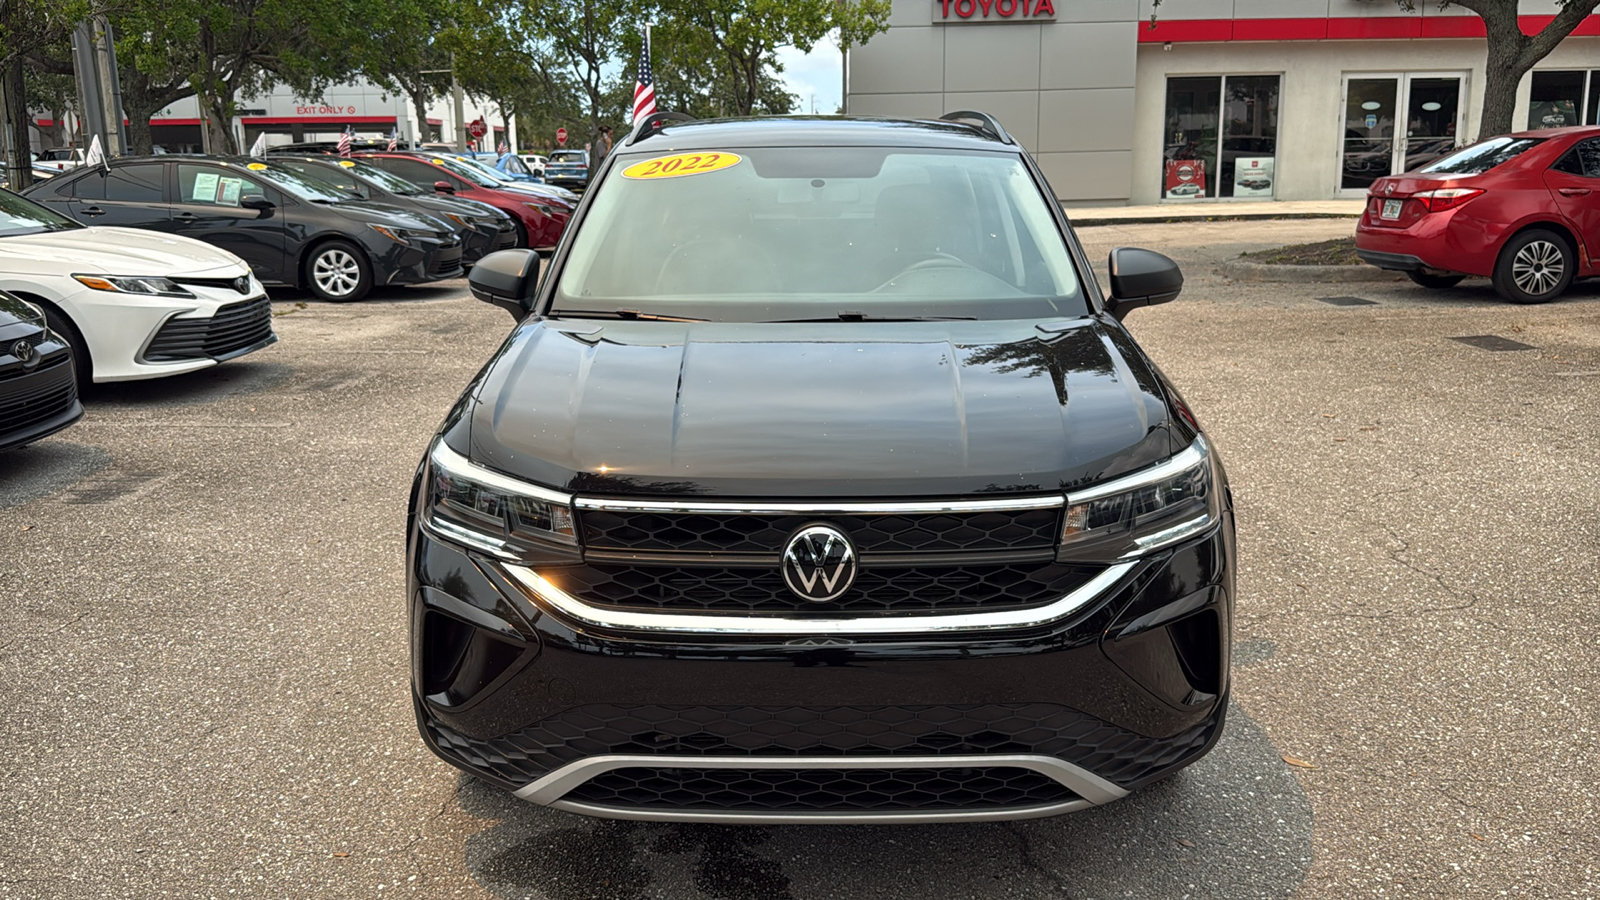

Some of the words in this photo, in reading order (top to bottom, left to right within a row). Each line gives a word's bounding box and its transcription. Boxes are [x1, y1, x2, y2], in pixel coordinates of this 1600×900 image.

[938, 0, 1056, 18] TOYOTA
[296, 106, 316, 115] EXIT
[318, 106, 344, 115] ONLY
[640, 154, 721, 177] 2022
